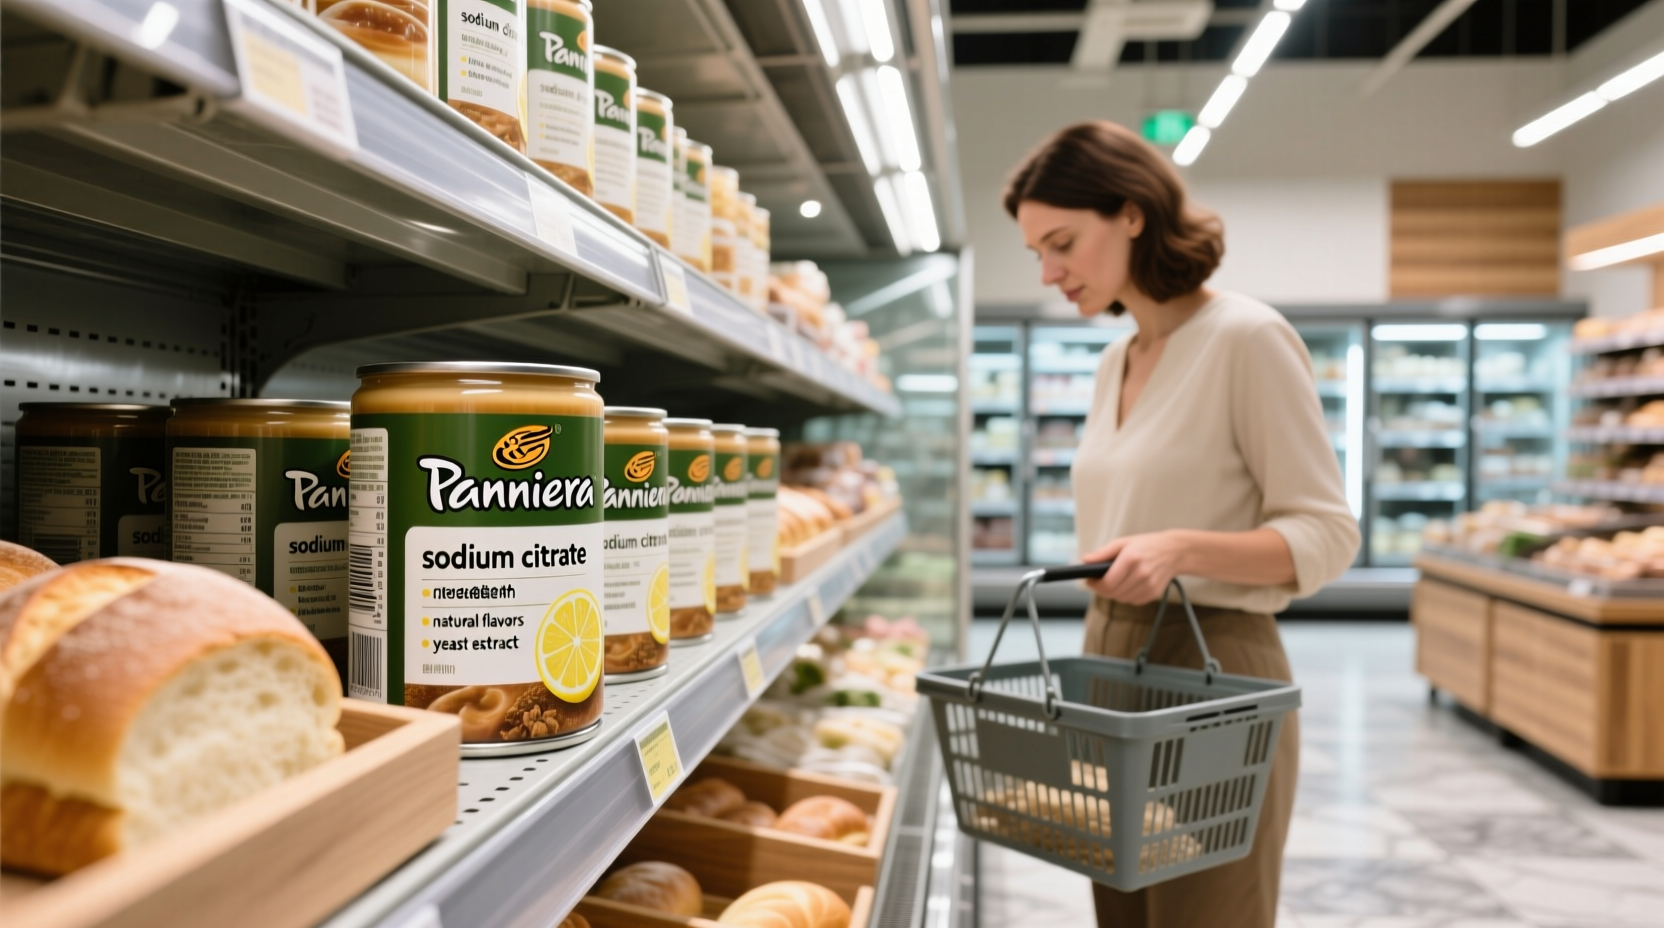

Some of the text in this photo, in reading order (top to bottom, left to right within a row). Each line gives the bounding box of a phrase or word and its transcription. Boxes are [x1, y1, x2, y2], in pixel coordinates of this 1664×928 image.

[418, 456, 595, 512] Panniera
[289, 535, 346, 554] sodium
[422, 543, 587, 569] sodium citrate
[433, 612, 525, 628] natural flavors
[433, 635, 519, 654] yeast extract
